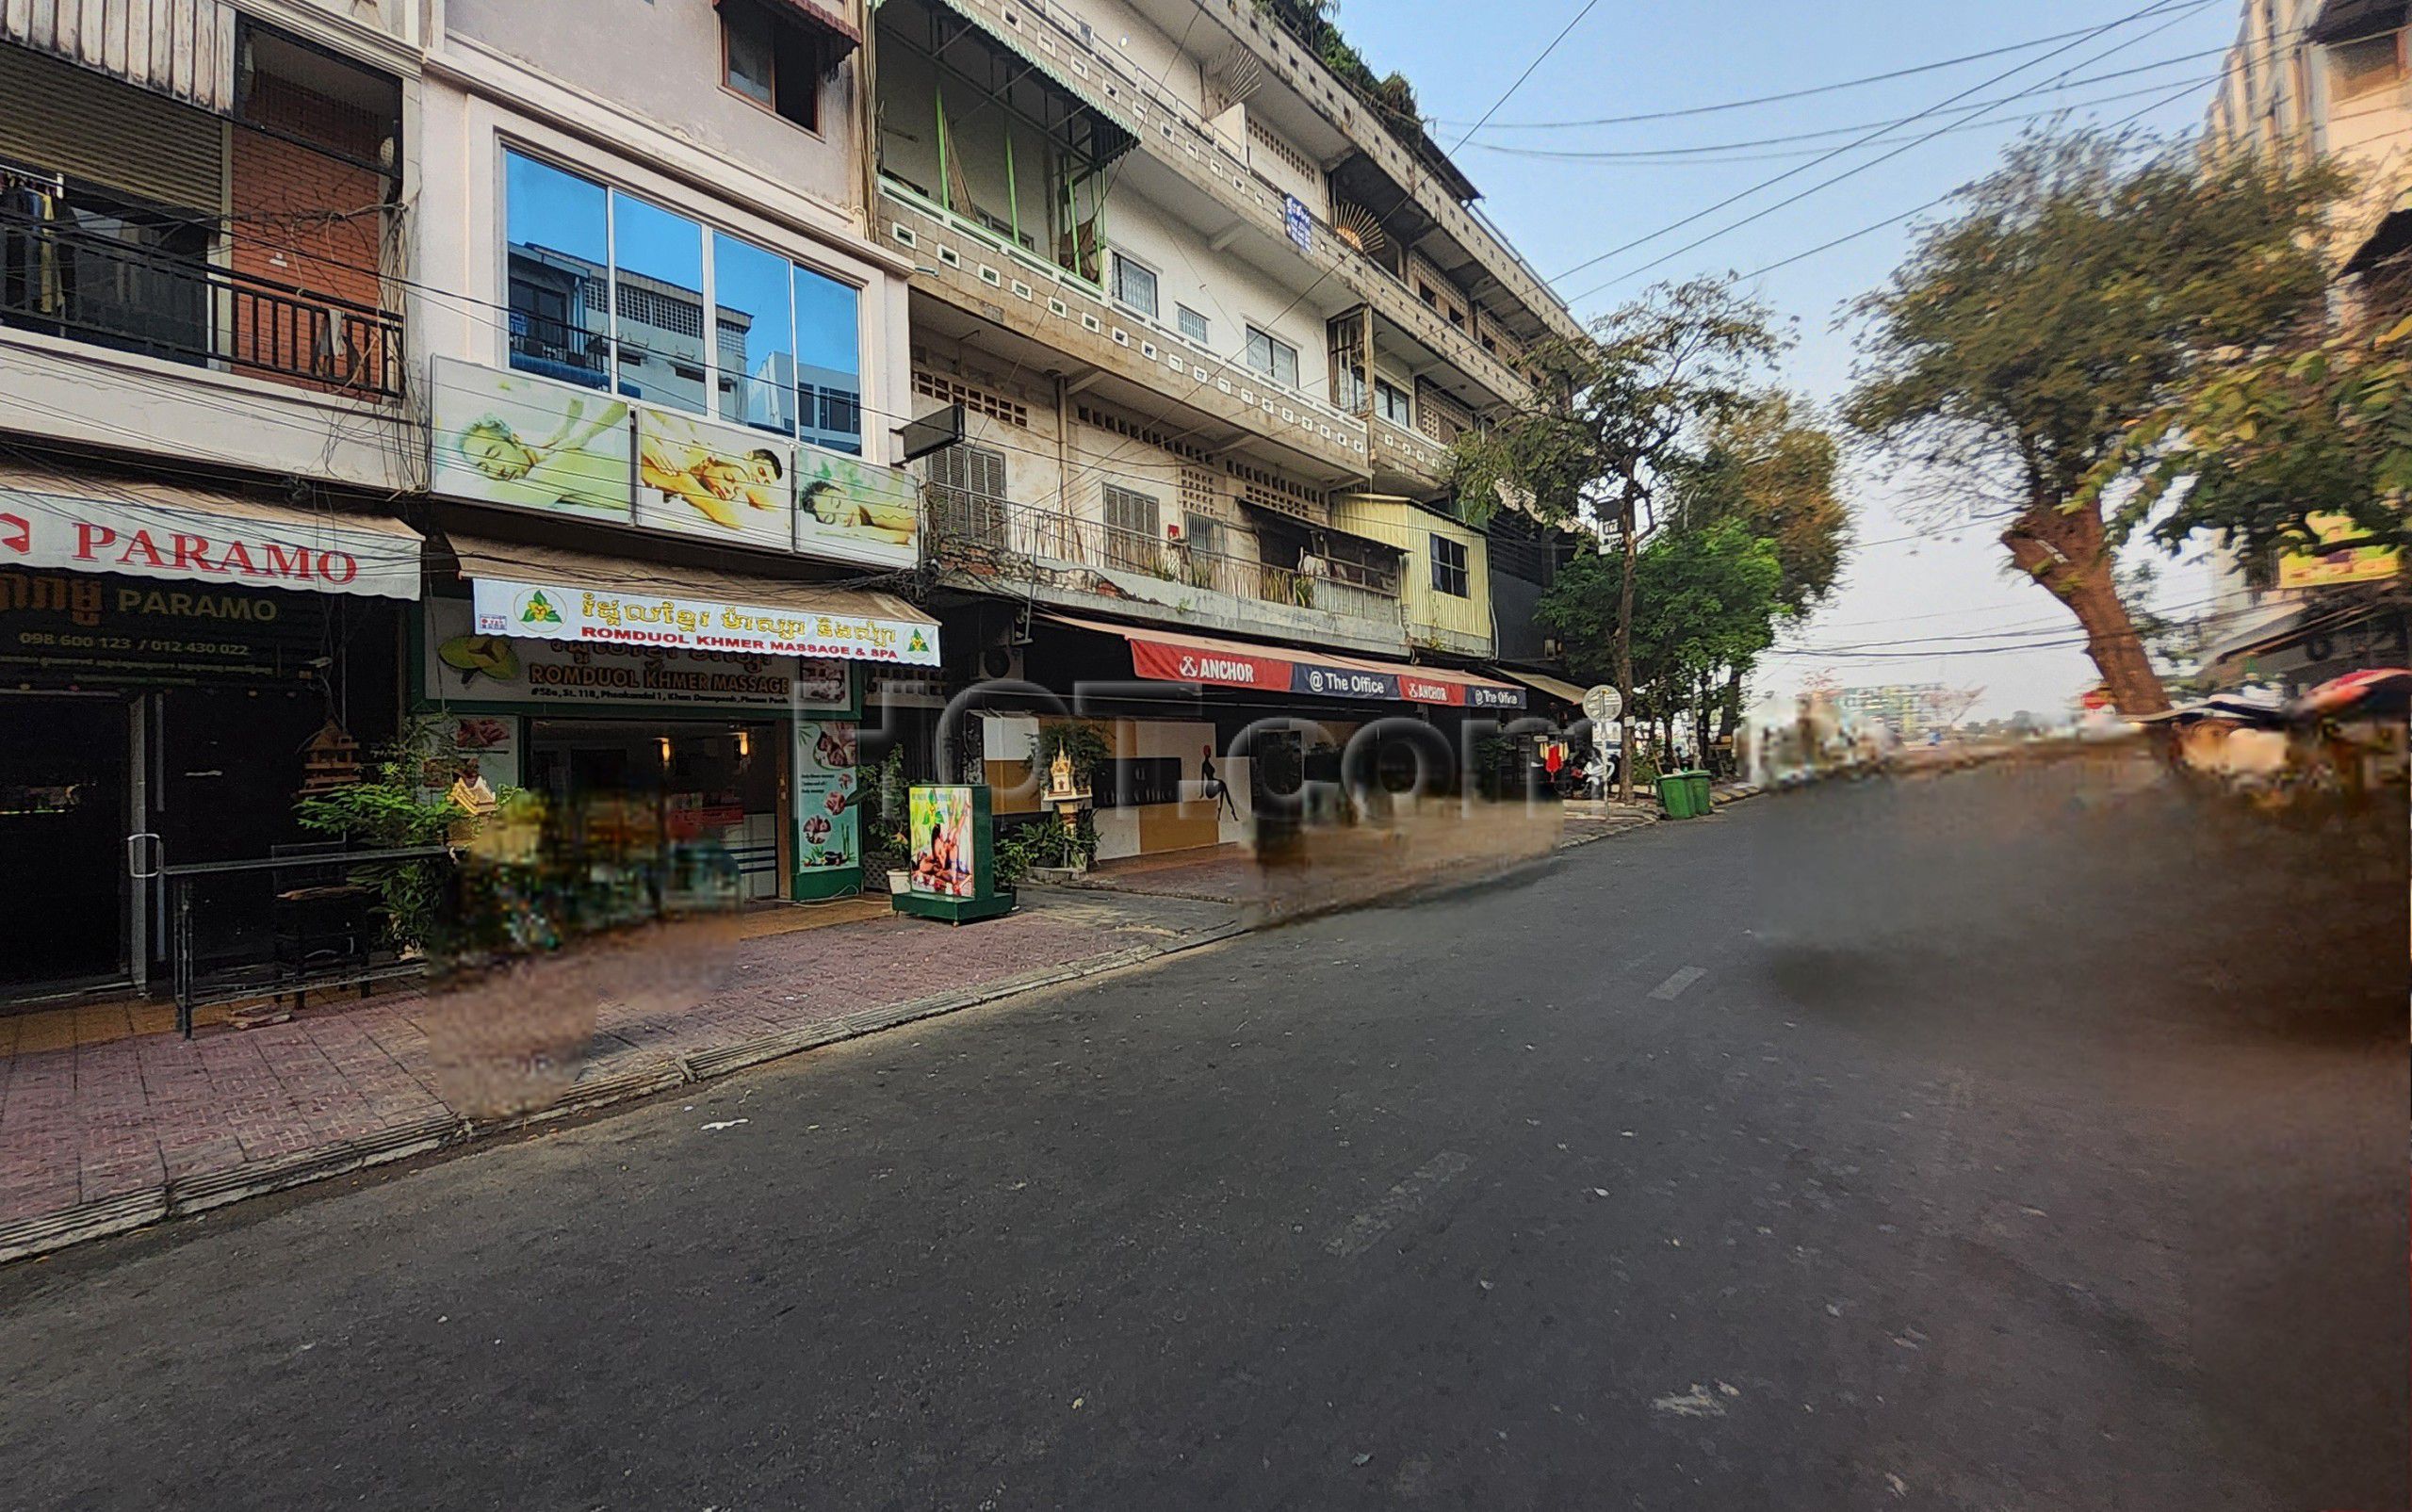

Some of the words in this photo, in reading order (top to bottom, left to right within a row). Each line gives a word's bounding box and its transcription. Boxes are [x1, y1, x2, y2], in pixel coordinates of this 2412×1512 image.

[72, 521, 358, 585] PARAMO
[117, 588, 278, 621] PARAMO
[19, 632, 56, 645] 098
[59, 634, 93, 648] 600
[99, 637, 131, 649] 123
[151, 640, 187, 652] 012
[187, 642, 216, 654] 430
[220, 643, 249, 655] 022
[581, 626, 690, 644] ROMDUOL
[696, 635, 764, 649] KHMER
[770, 641, 850, 655] MASSAGE
[856, 648, 865, 657] &
[871, 648, 898, 659] SPA
[529, 663, 640, 688] ROMDUOL
[644, 670, 709, 690] KHMER
[710, 674, 790, 694] MASSAGE
[1199, 658, 1254, 683] ANCHOR
[1309, 671, 1324, 692] @
[1326, 672, 1348, 691] The
[1351, 675, 1384, 694] Office
[1419, 684, 1447, 701] ANCHOR
[1484, 690, 1497, 703] The
